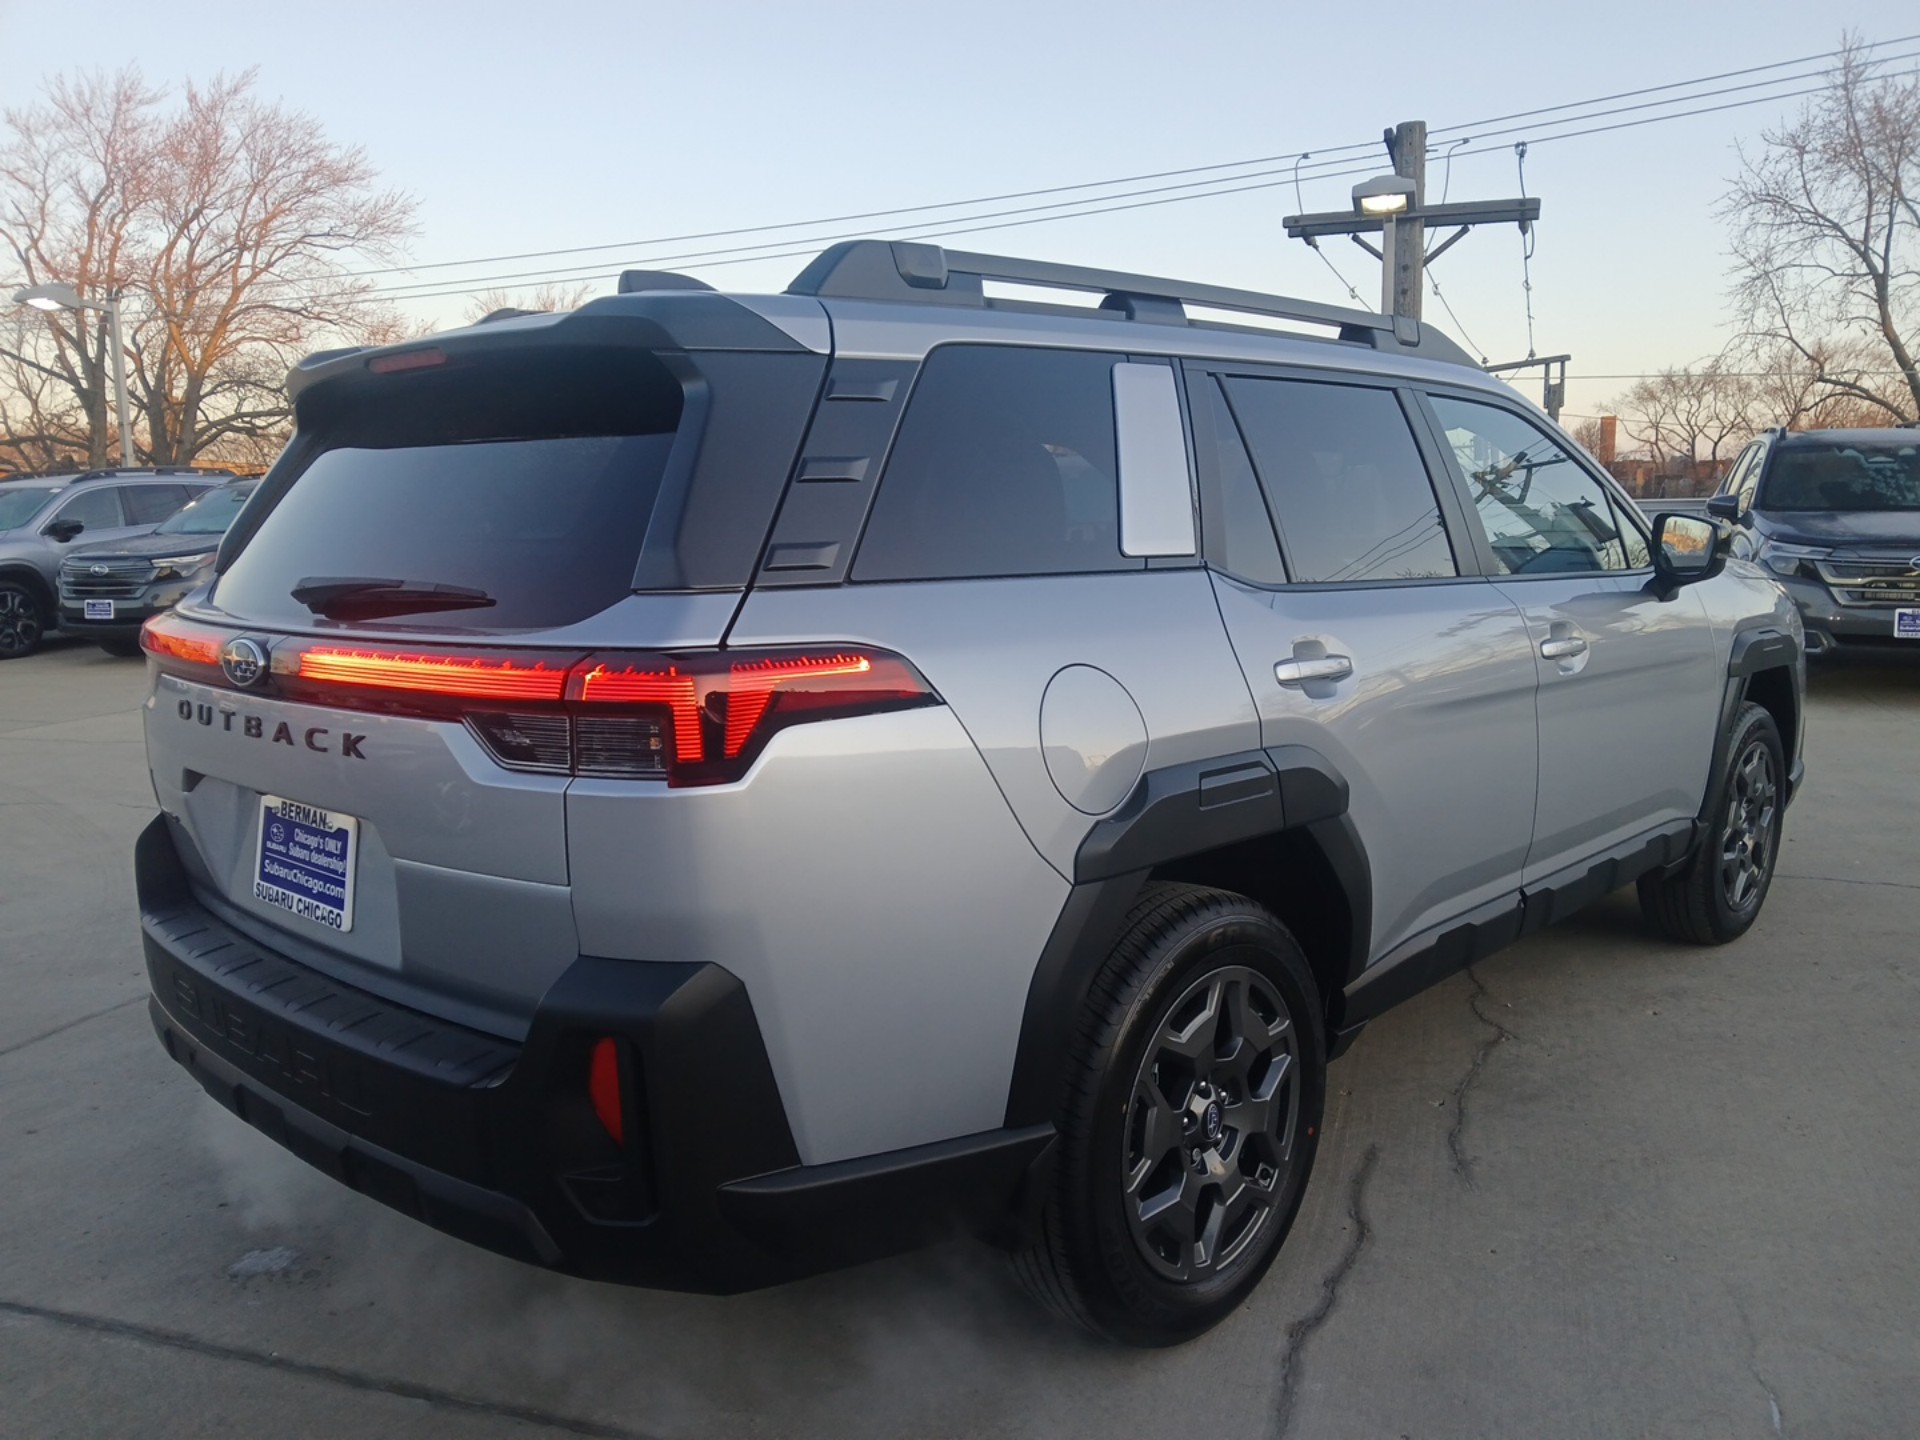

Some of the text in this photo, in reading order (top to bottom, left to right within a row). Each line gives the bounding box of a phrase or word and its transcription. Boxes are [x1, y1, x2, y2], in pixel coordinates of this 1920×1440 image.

[178, 699, 367, 760] OUTBACK
[281, 801, 328, 829] BERMAN
[266, 841, 287, 853] SUBARU
[288, 842, 346, 875] Subaru dealership!
[294, 828, 342, 854] Chicago's ONLY
[264, 859, 345, 899] SubaruChicago.com
[255, 882, 342, 929] SUBARU CHICAGO
[173, 971, 372, 1118] SUBARU
